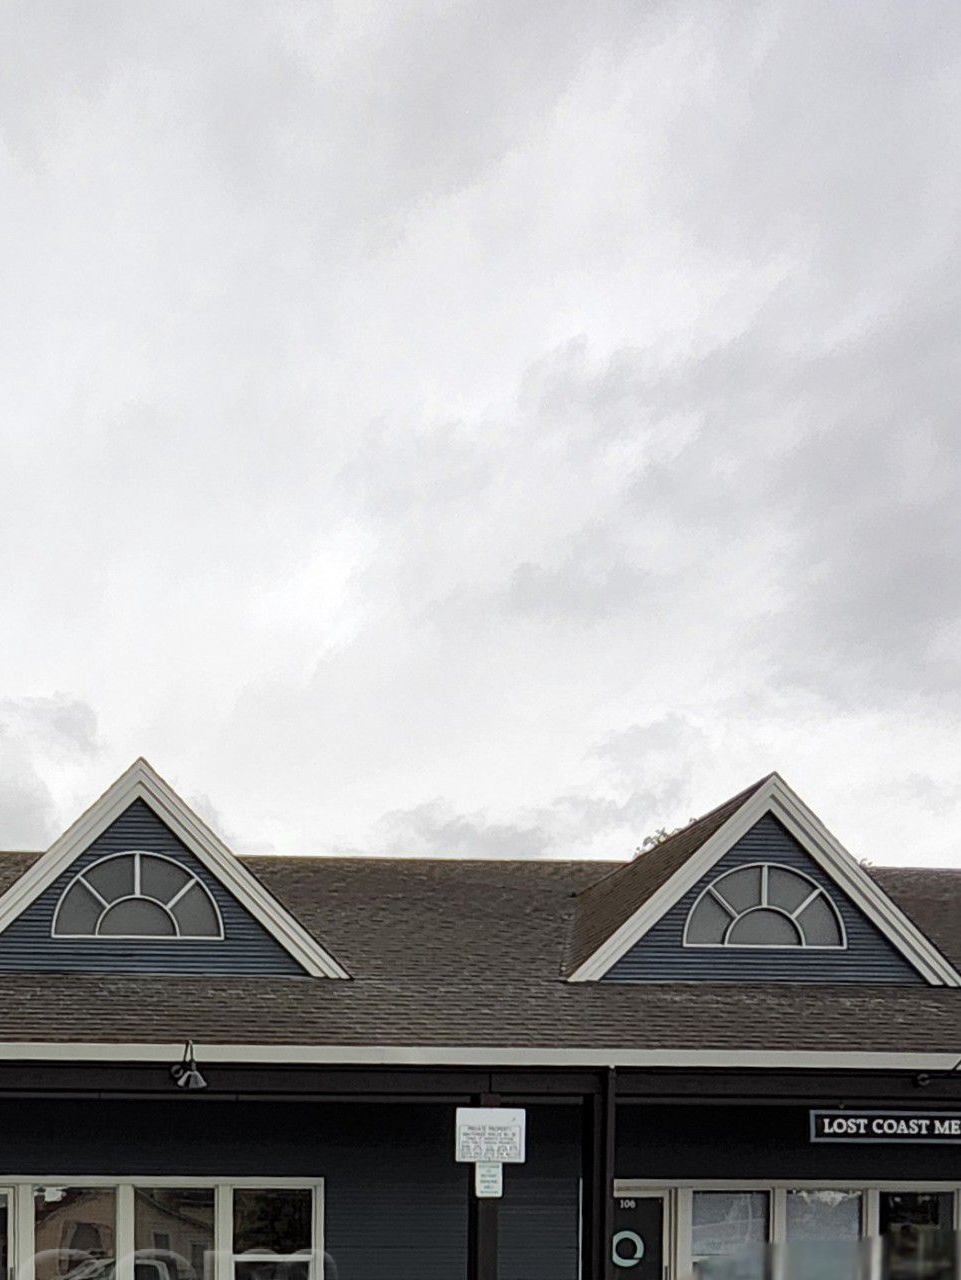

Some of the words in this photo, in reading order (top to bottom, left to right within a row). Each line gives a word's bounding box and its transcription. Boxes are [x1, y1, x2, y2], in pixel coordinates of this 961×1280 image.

[823, 1118, 868, 1134] LOST
[872, 1118, 930, 1135] COAST
[620, 1200, 637, 1209] 106
